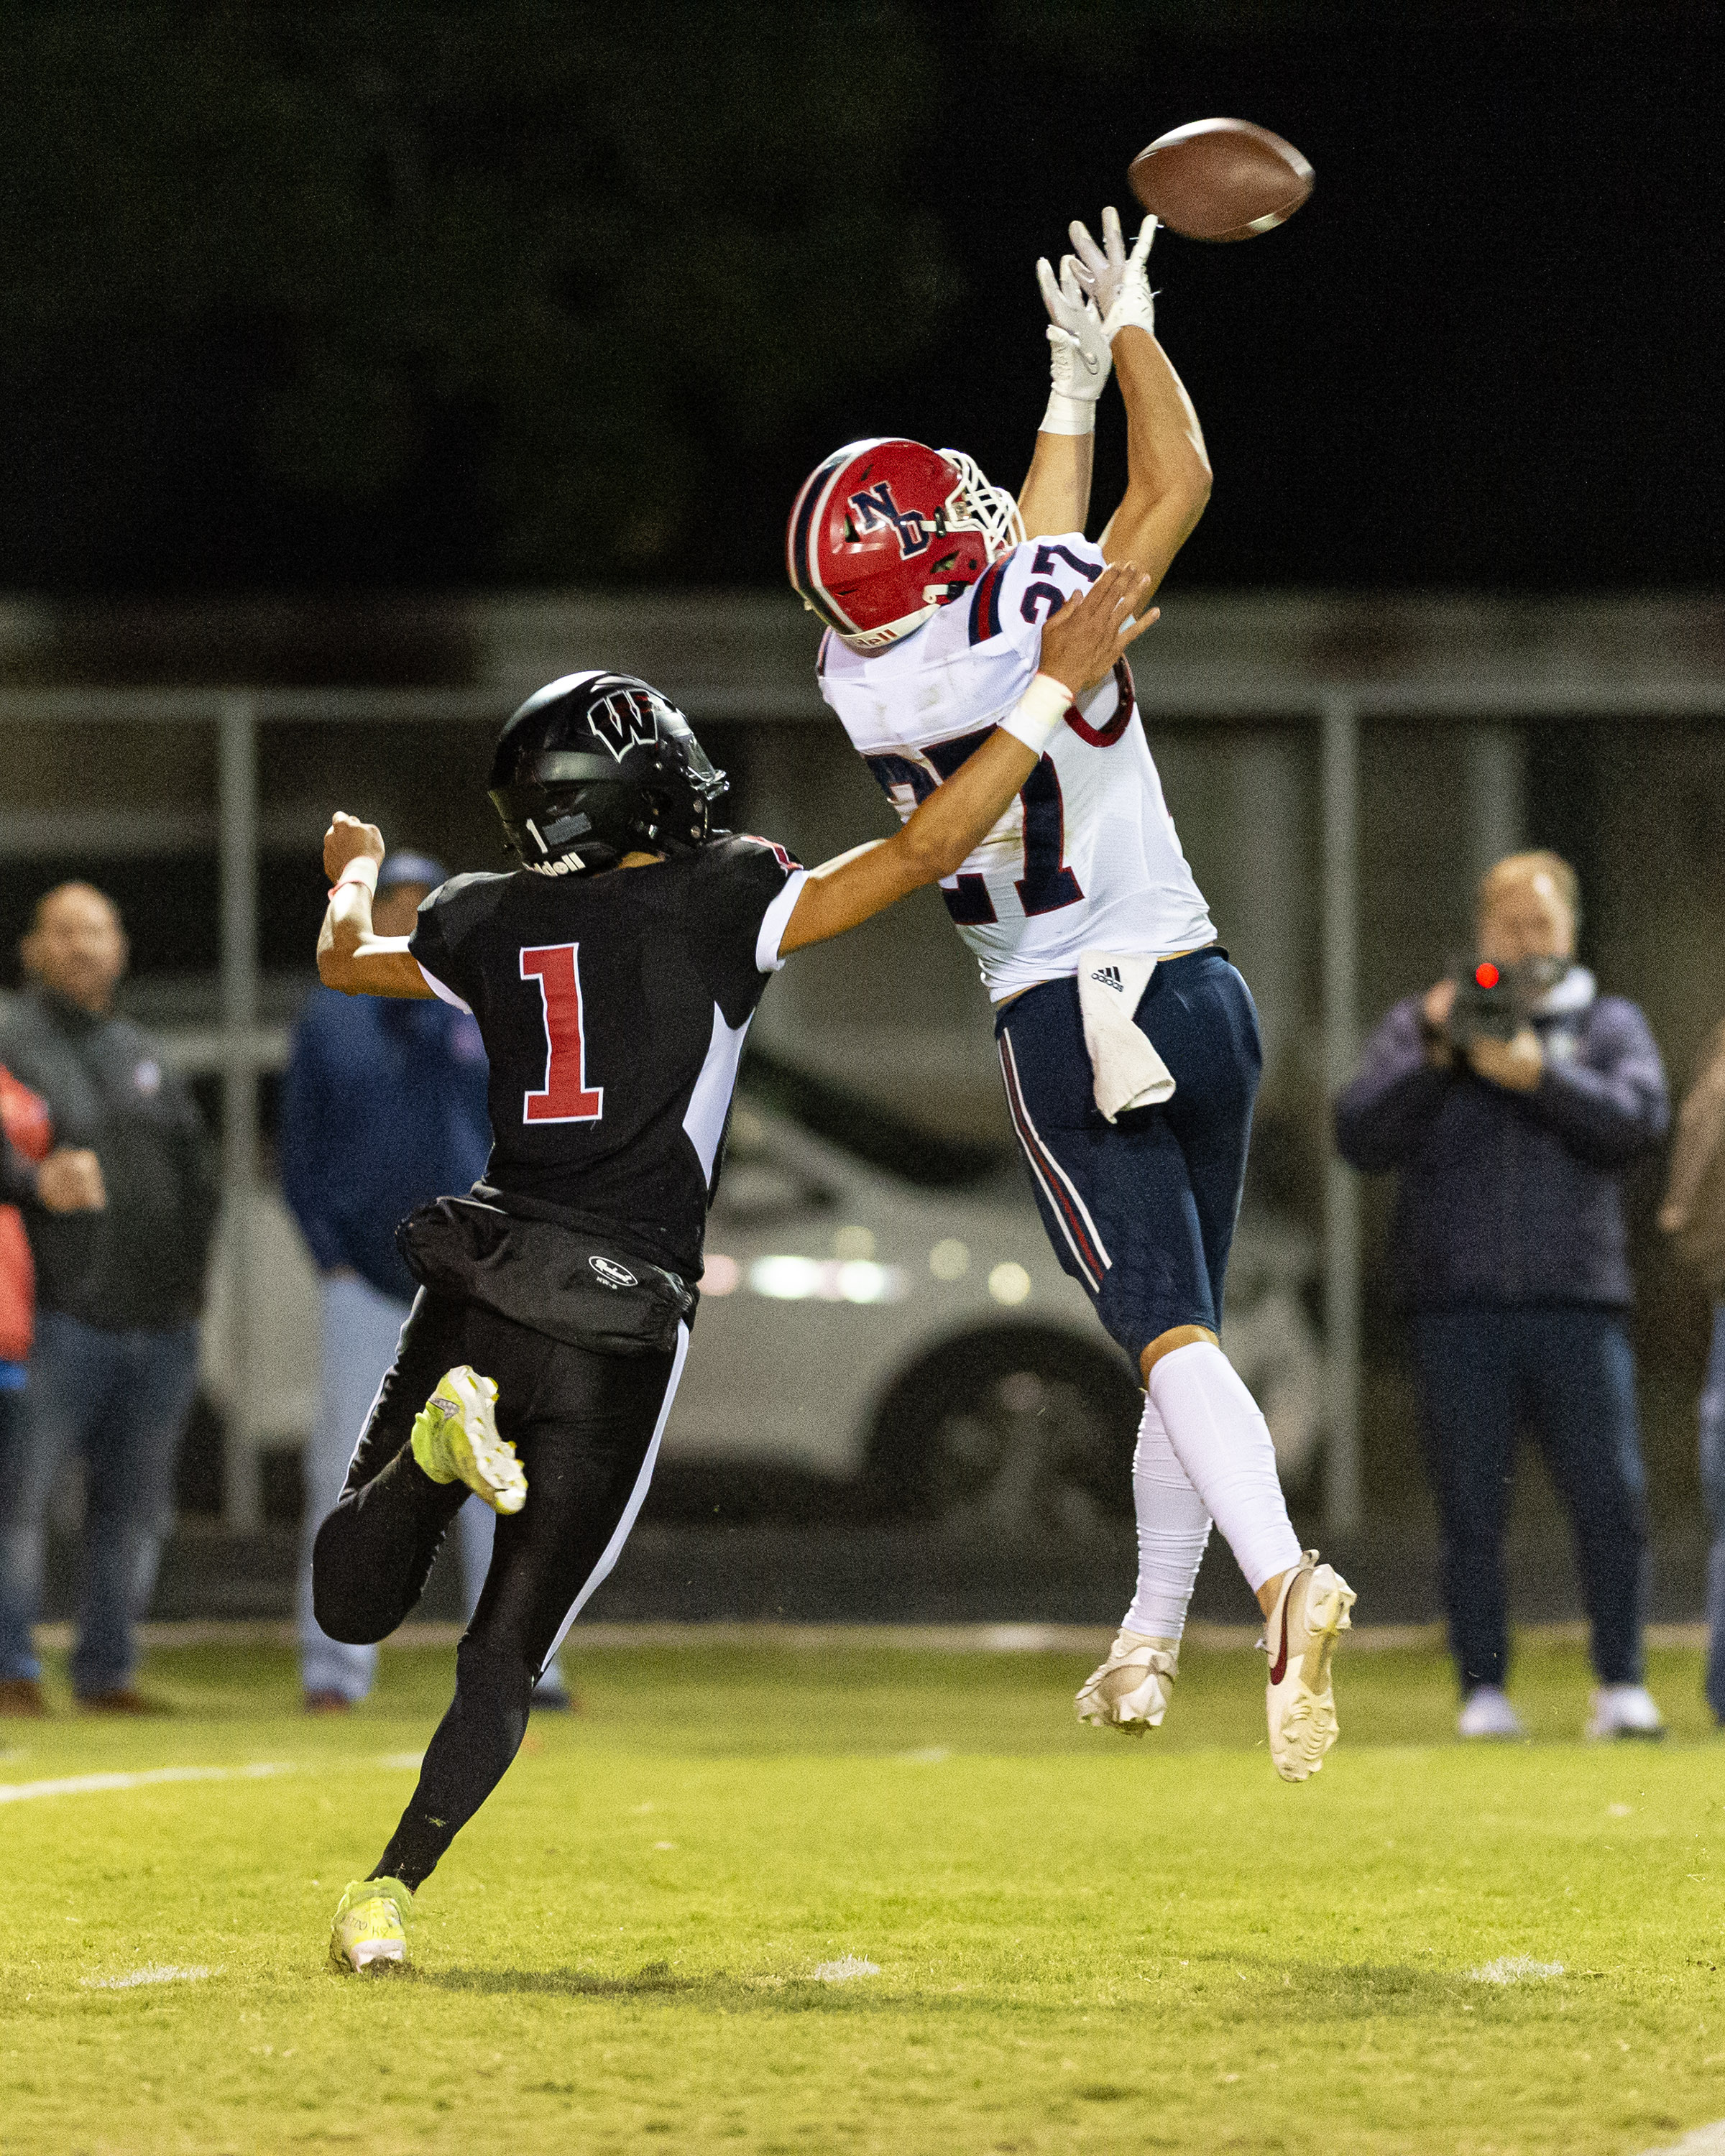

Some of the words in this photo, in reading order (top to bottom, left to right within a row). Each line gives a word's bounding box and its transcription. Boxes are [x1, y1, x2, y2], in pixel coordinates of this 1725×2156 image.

[587, 688, 658, 764] W
[1091, 972, 1124, 992] adidas
[519, 942, 604, 1125] 1
